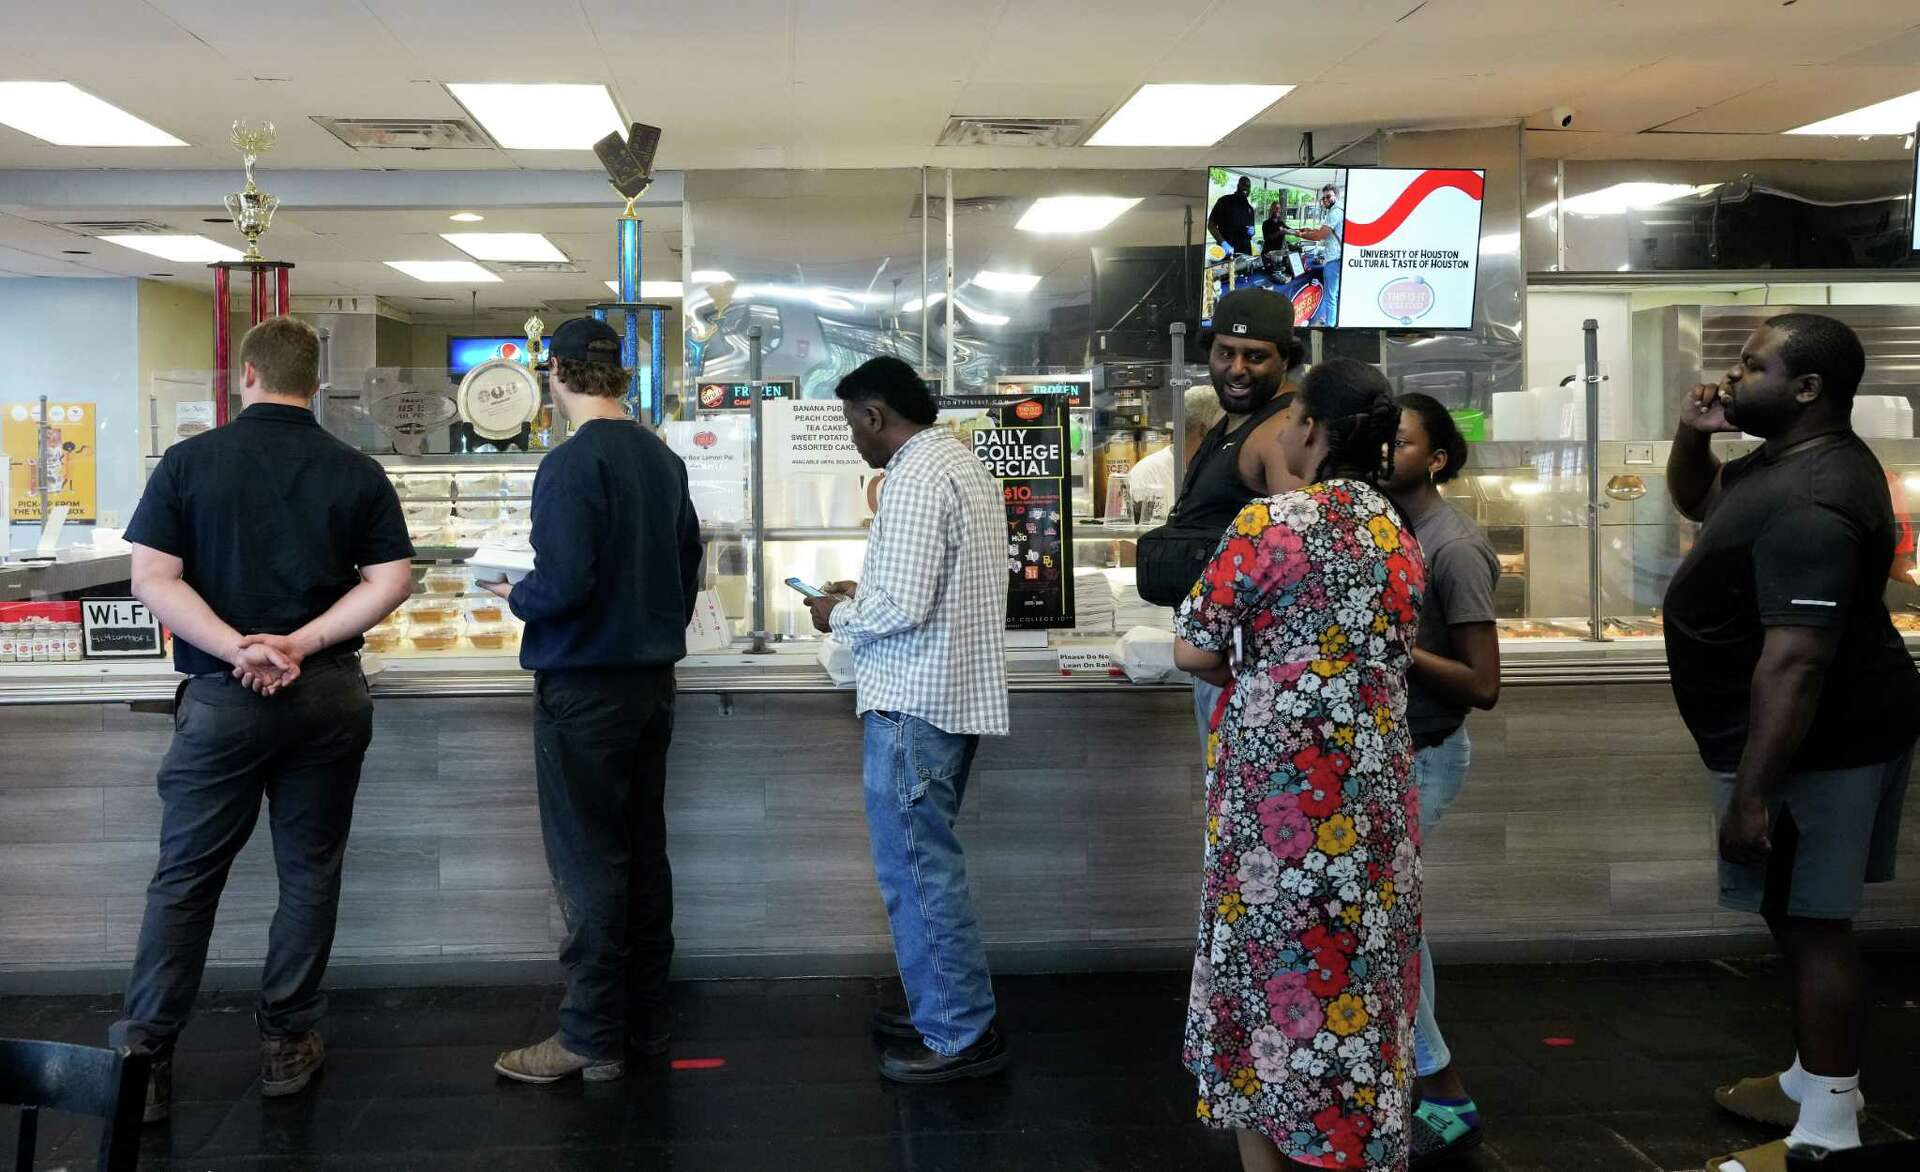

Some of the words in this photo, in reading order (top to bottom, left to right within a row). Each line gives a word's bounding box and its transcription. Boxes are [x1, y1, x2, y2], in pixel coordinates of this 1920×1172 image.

[1360, 249, 1406, 258] UNIVERSITY
[1409, 250, 1419, 258] OF
[1420, 249, 1459, 259] HOUSTON
[1348, 259, 1389, 268] CULTURAL
[1392, 259, 1417, 268] TASTE
[1419, 260, 1429, 268] OF
[1430, 259, 1469, 269] HOUSTON
[734, 386, 781, 397] FRZEN
[974, 430, 1027, 445] DAILY
[974, 445, 1059, 461] COLLEGE
[983, 460, 1050, 477] PECIAL
[1004, 486, 1032, 500] $10
[14, 507, 31, 515] THE
